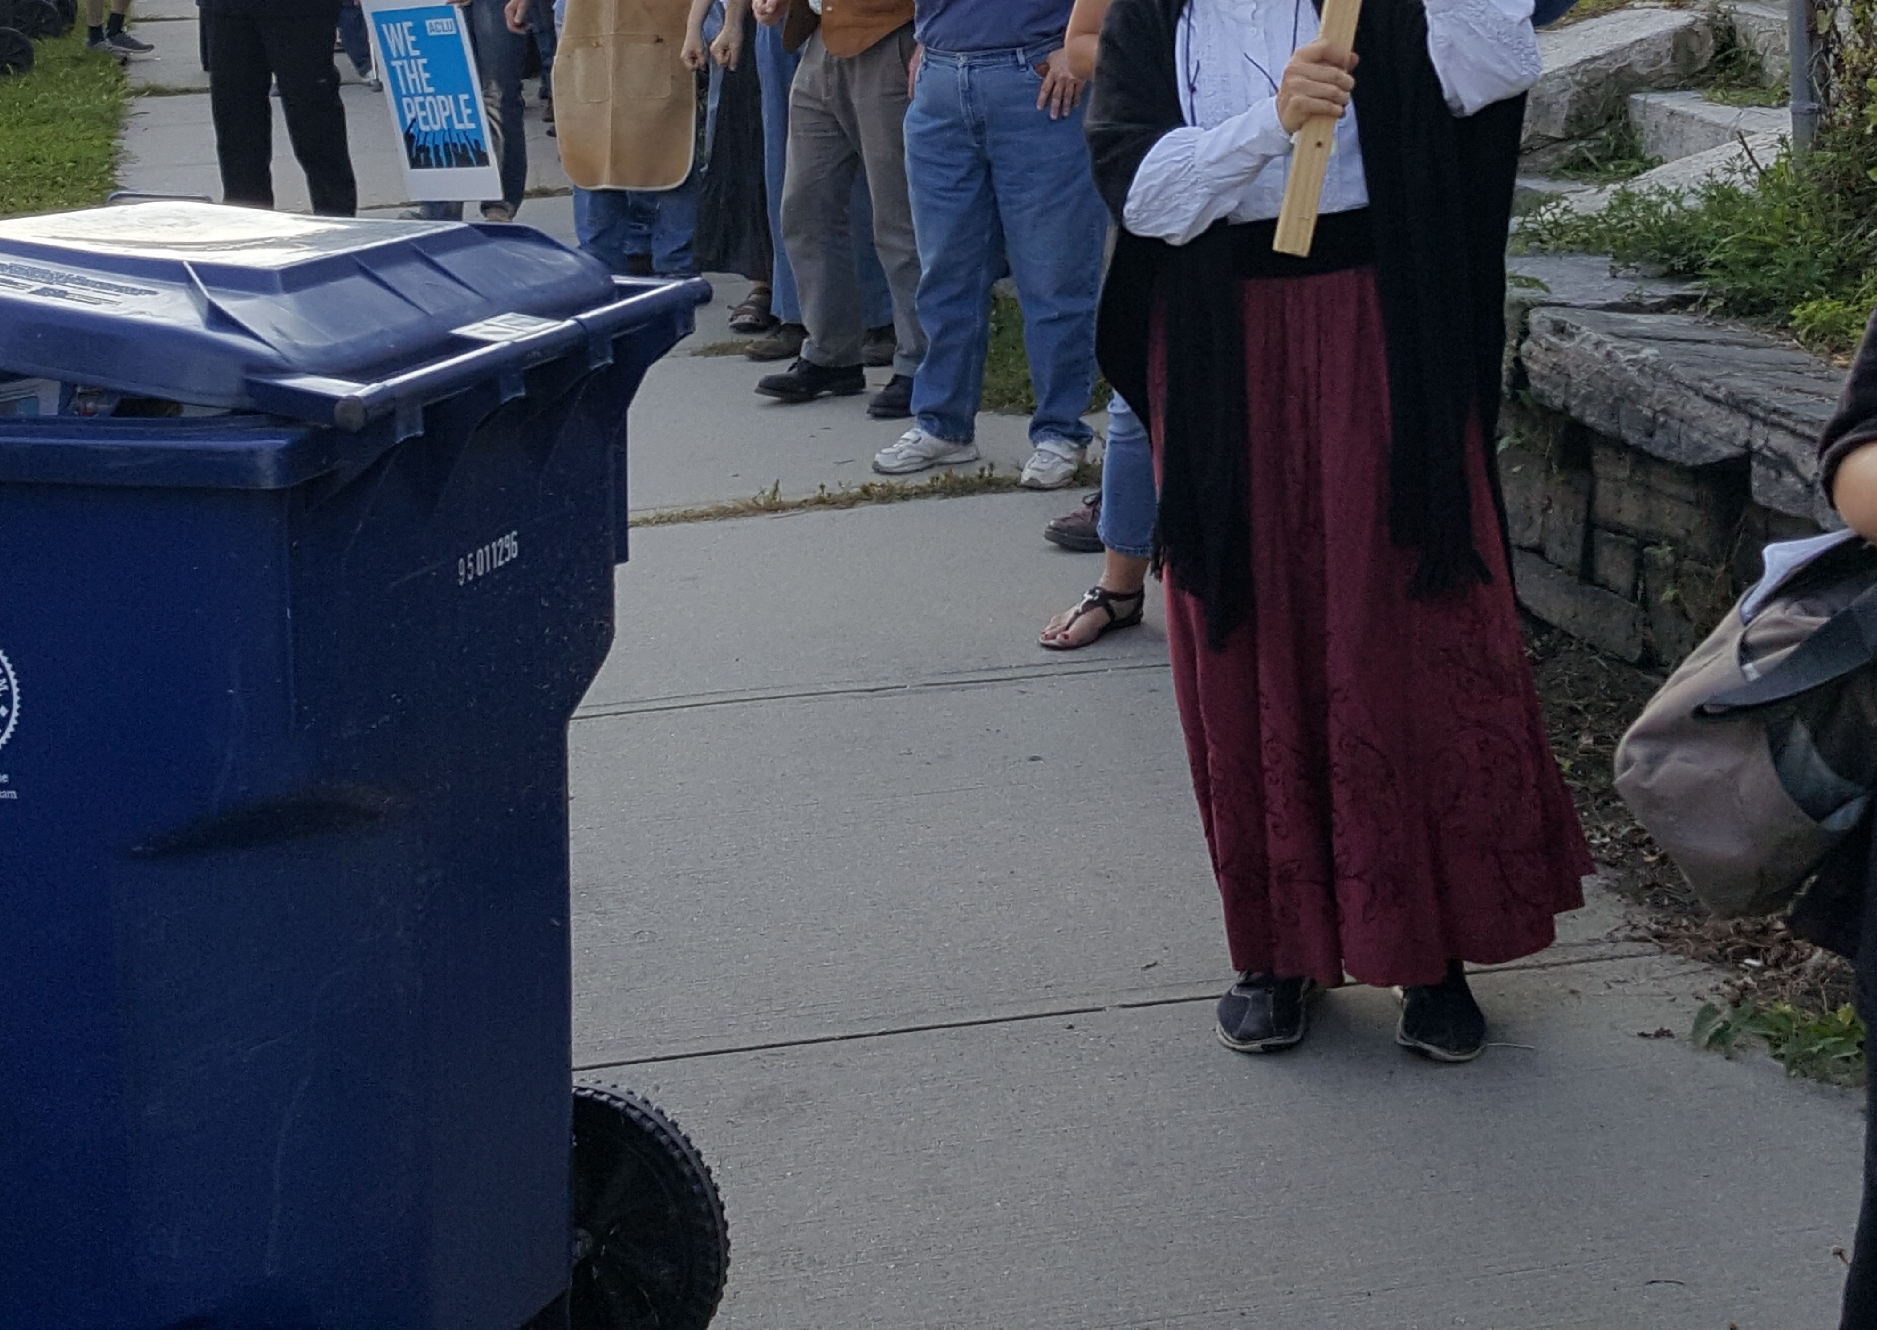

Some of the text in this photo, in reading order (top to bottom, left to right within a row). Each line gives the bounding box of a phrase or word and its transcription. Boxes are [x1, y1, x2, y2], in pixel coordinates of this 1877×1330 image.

[381, 21, 421, 58] WE
[427, 20, 455, 34] ACLU
[390, 58, 435, 95] THE
[402, 94, 476, 132] PEOPLE
[458, 530, 518, 586] 95011296
